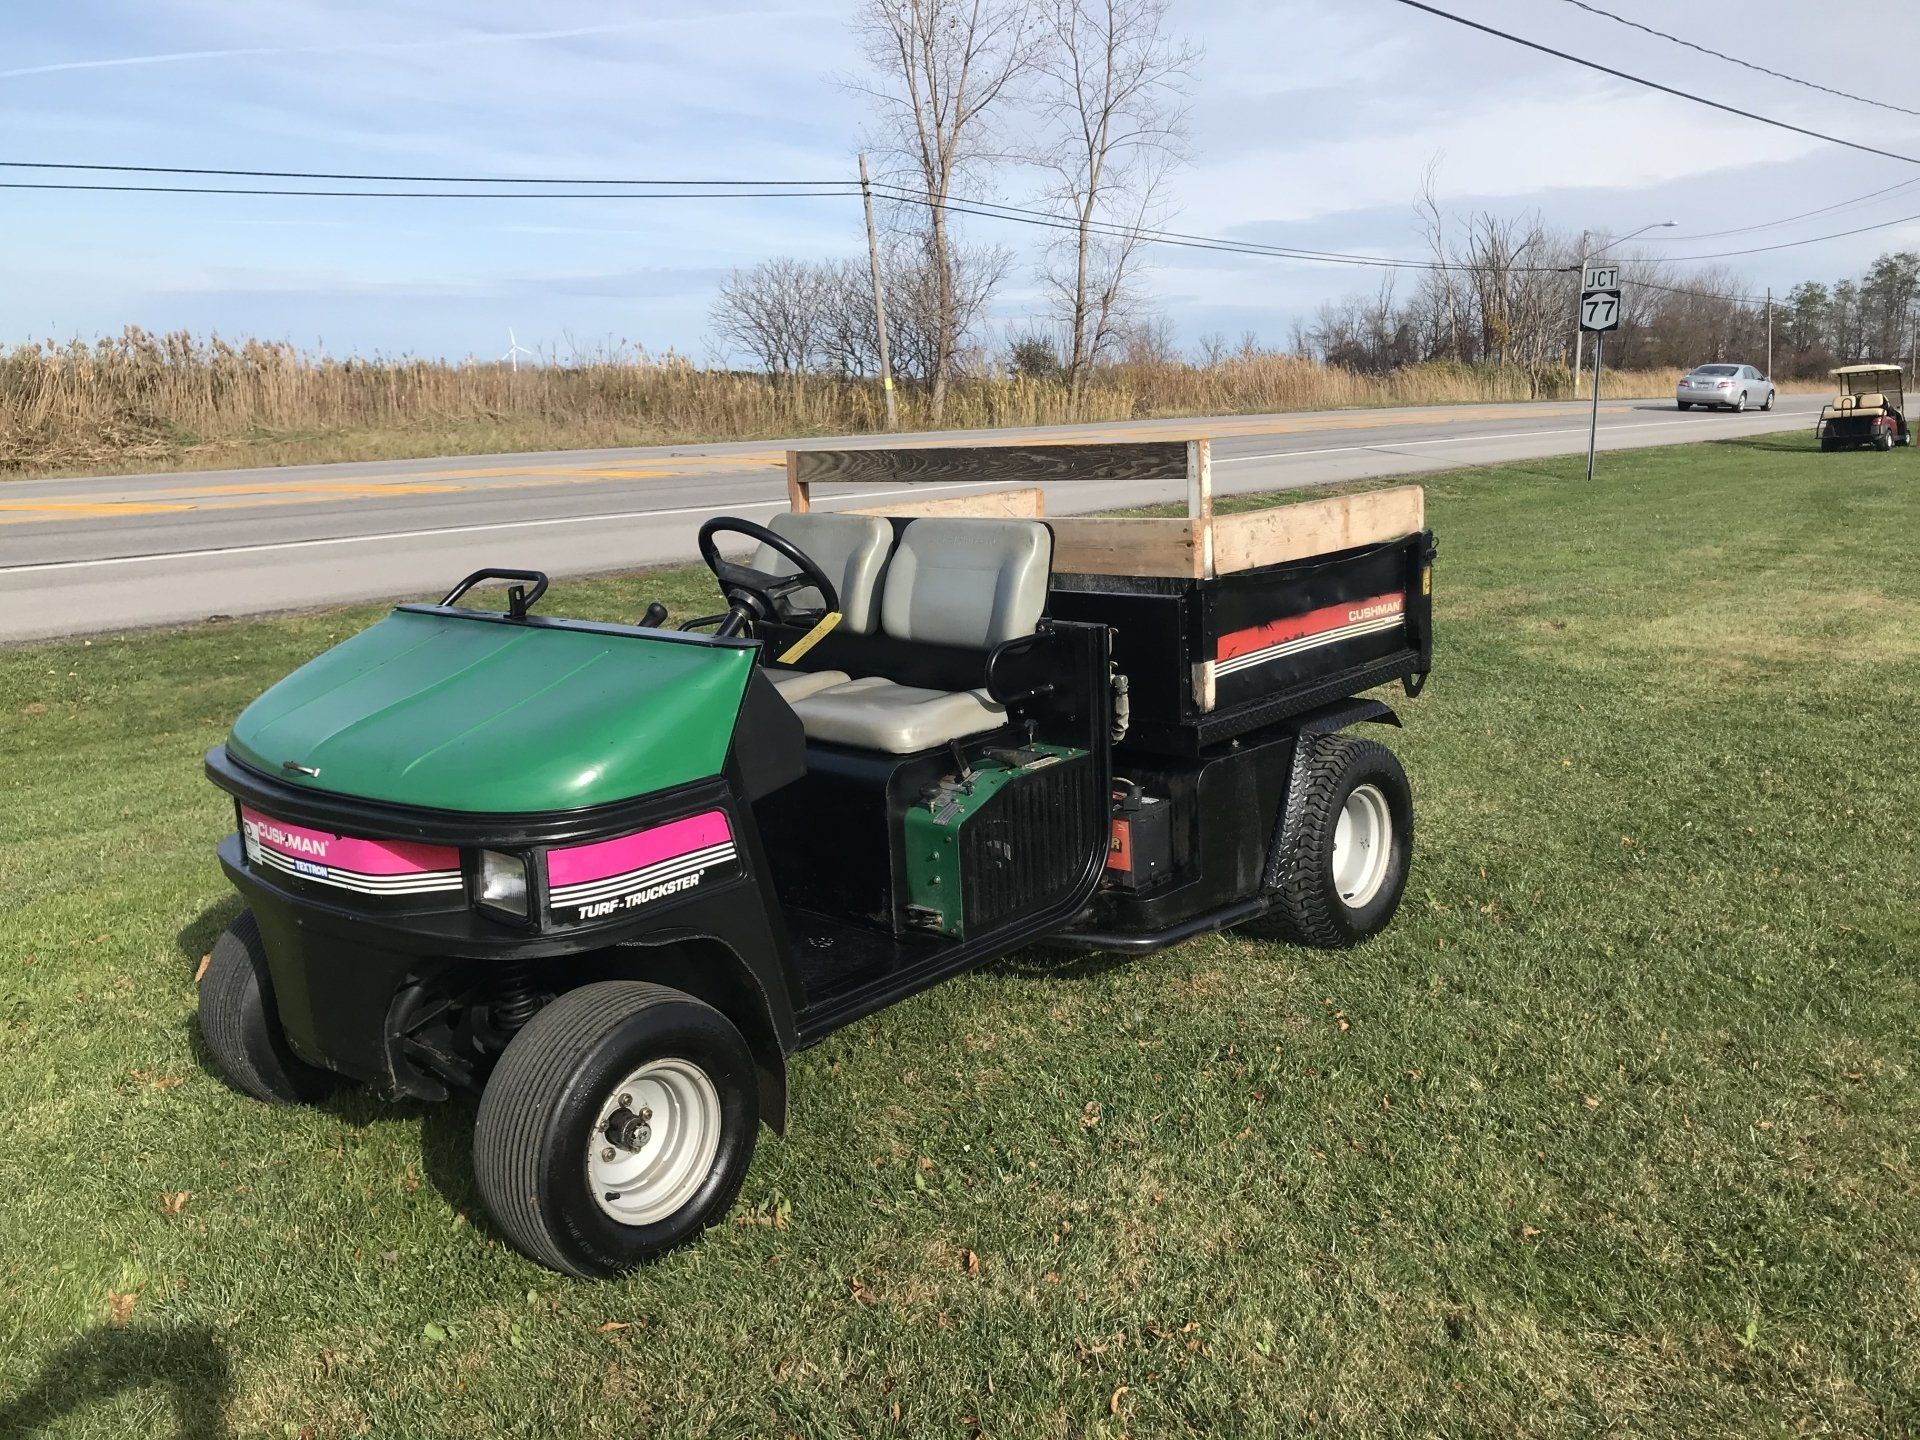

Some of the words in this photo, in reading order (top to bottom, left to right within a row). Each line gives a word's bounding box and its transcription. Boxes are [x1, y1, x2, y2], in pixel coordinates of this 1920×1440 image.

[1587, 270, 1617, 288] JCT
[1585, 300, 1616, 322] 77
[1348, 601, 1401, 622] CUSHMAN
[258, 822, 327, 857] CUSHMAN
[295, 860, 328, 877] TEXTRON
[578, 873, 700, 920] TURF-TRUCKSTER
